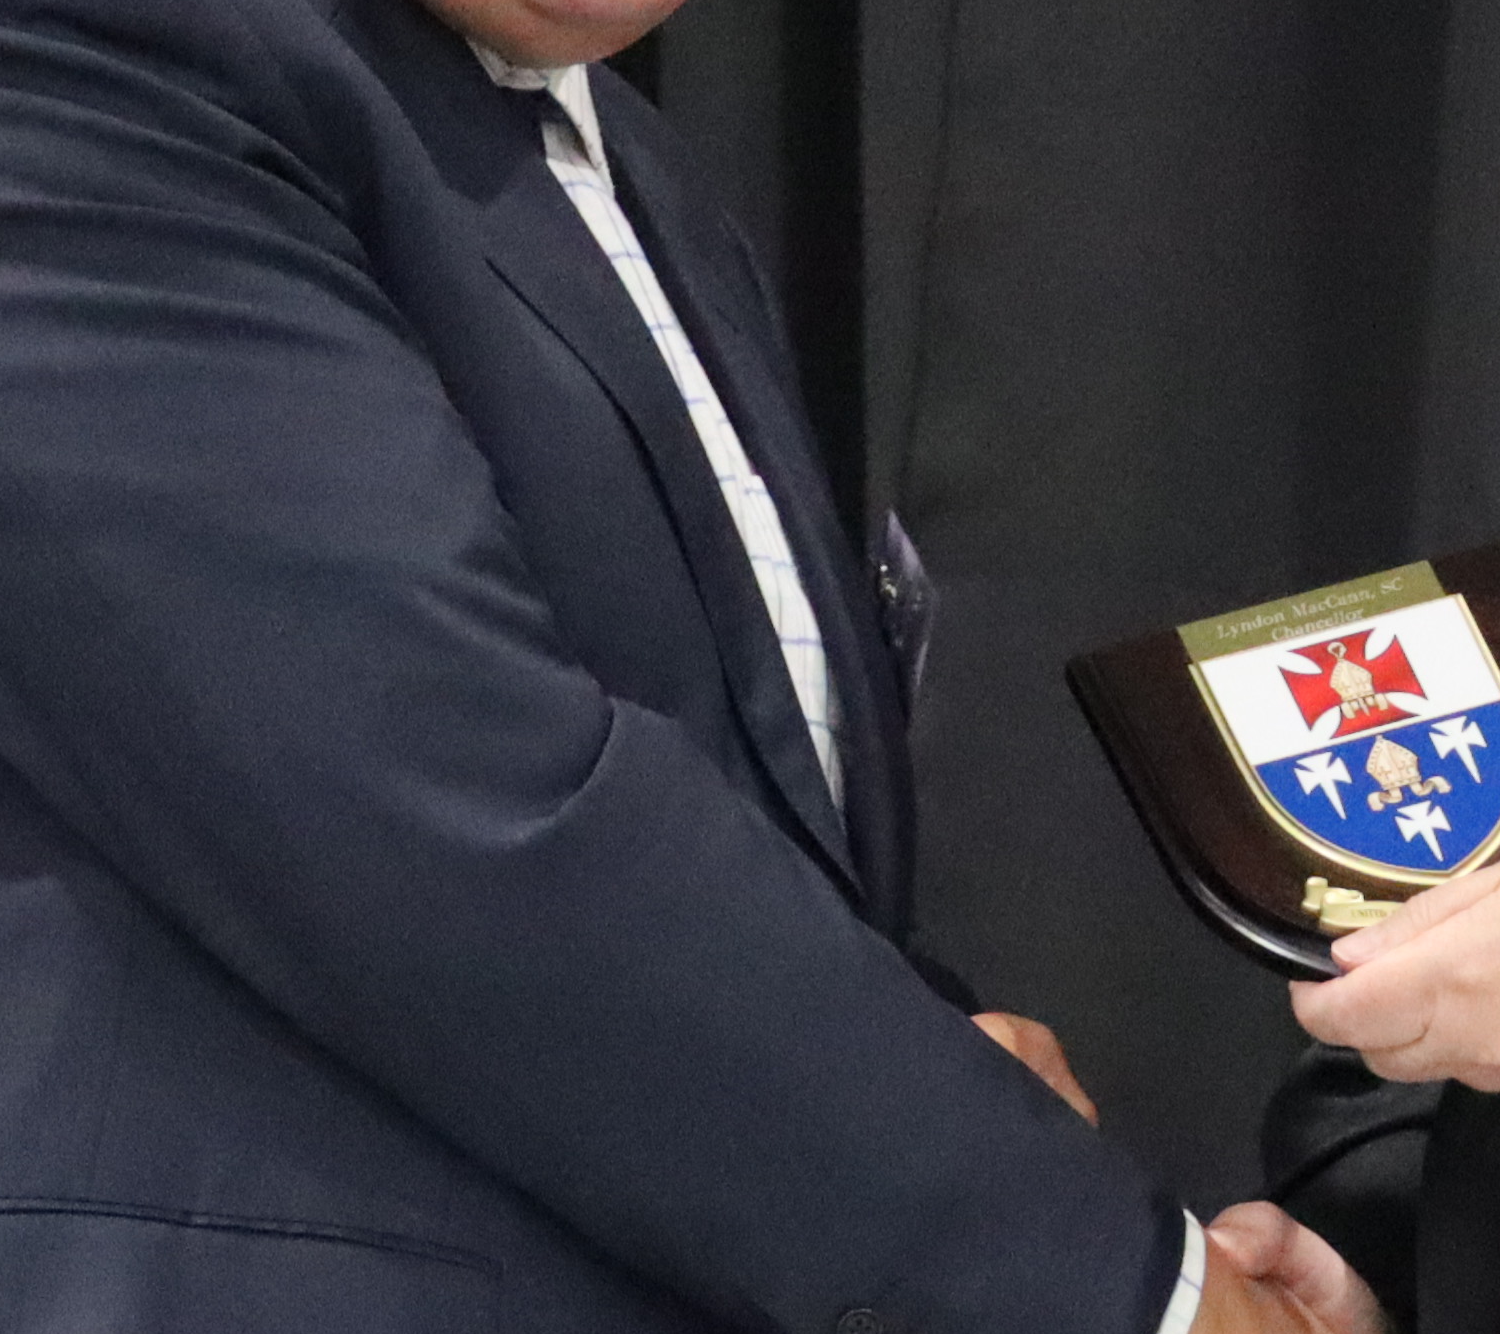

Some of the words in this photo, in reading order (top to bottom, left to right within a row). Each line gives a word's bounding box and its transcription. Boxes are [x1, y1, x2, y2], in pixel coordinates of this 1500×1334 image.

[1216, 612, 1285, 640] Lyndon
[1380, 577, 1404, 595] SC
[1271, 608, 1364, 641] Chancellor
